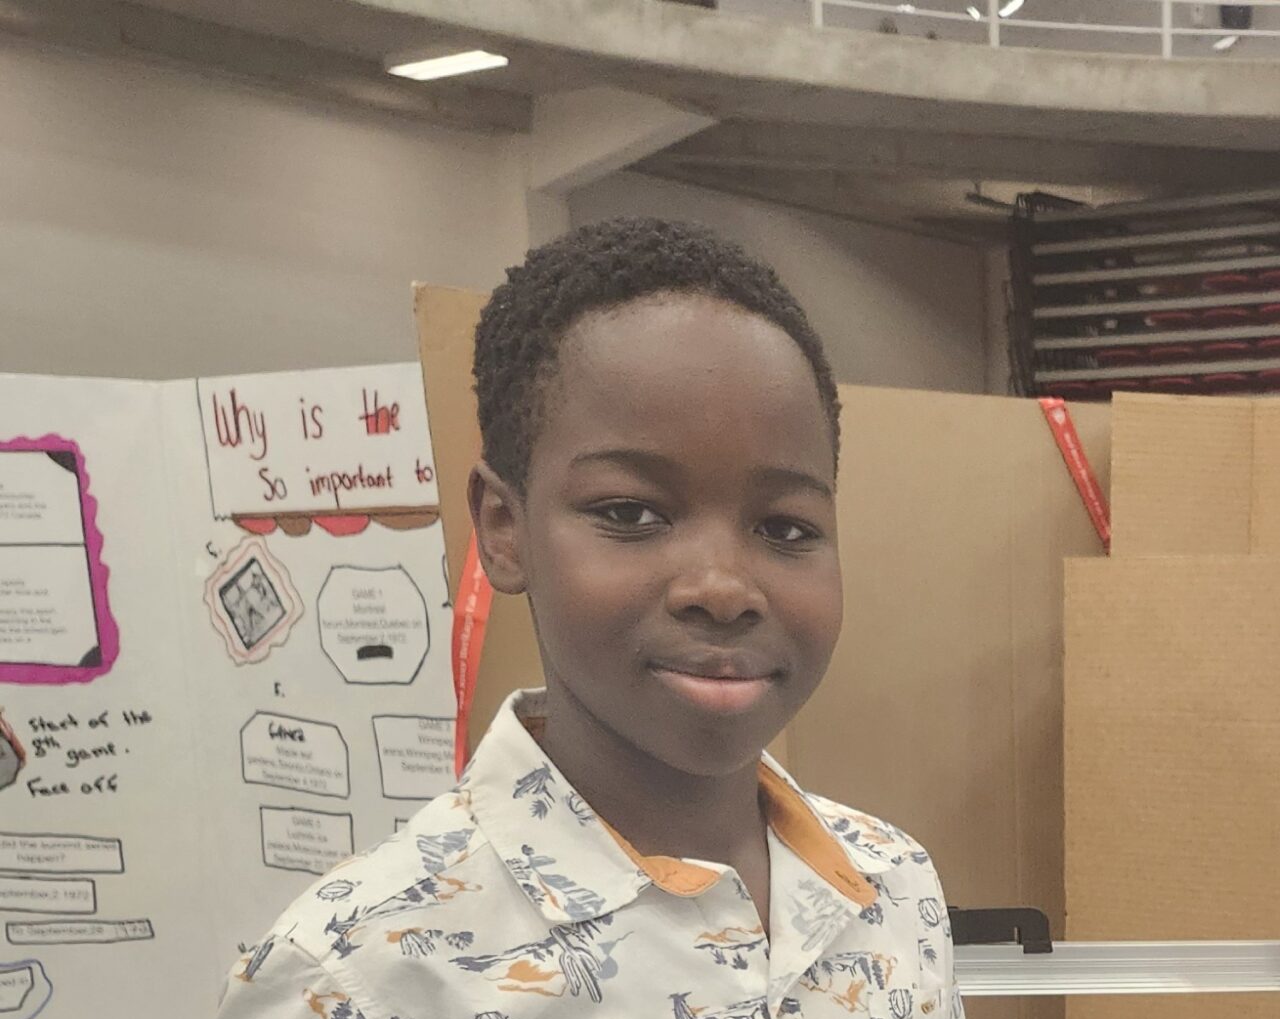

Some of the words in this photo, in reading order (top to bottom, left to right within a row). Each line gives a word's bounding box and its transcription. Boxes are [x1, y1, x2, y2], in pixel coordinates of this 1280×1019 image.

[213, 388, 268, 459] Why
[300, 397, 324, 439] is
[358, 388, 401, 436] the
[259, 467, 287, 501] So
[309, 469, 394, 510] important
[415, 459, 433, 483] to
[88, 710, 109, 729] of
[122, 710, 152, 726] the
[31, 735, 61, 758] 8th
[27, 776, 70, 798] Face
[80, 773, 118, 794] off
